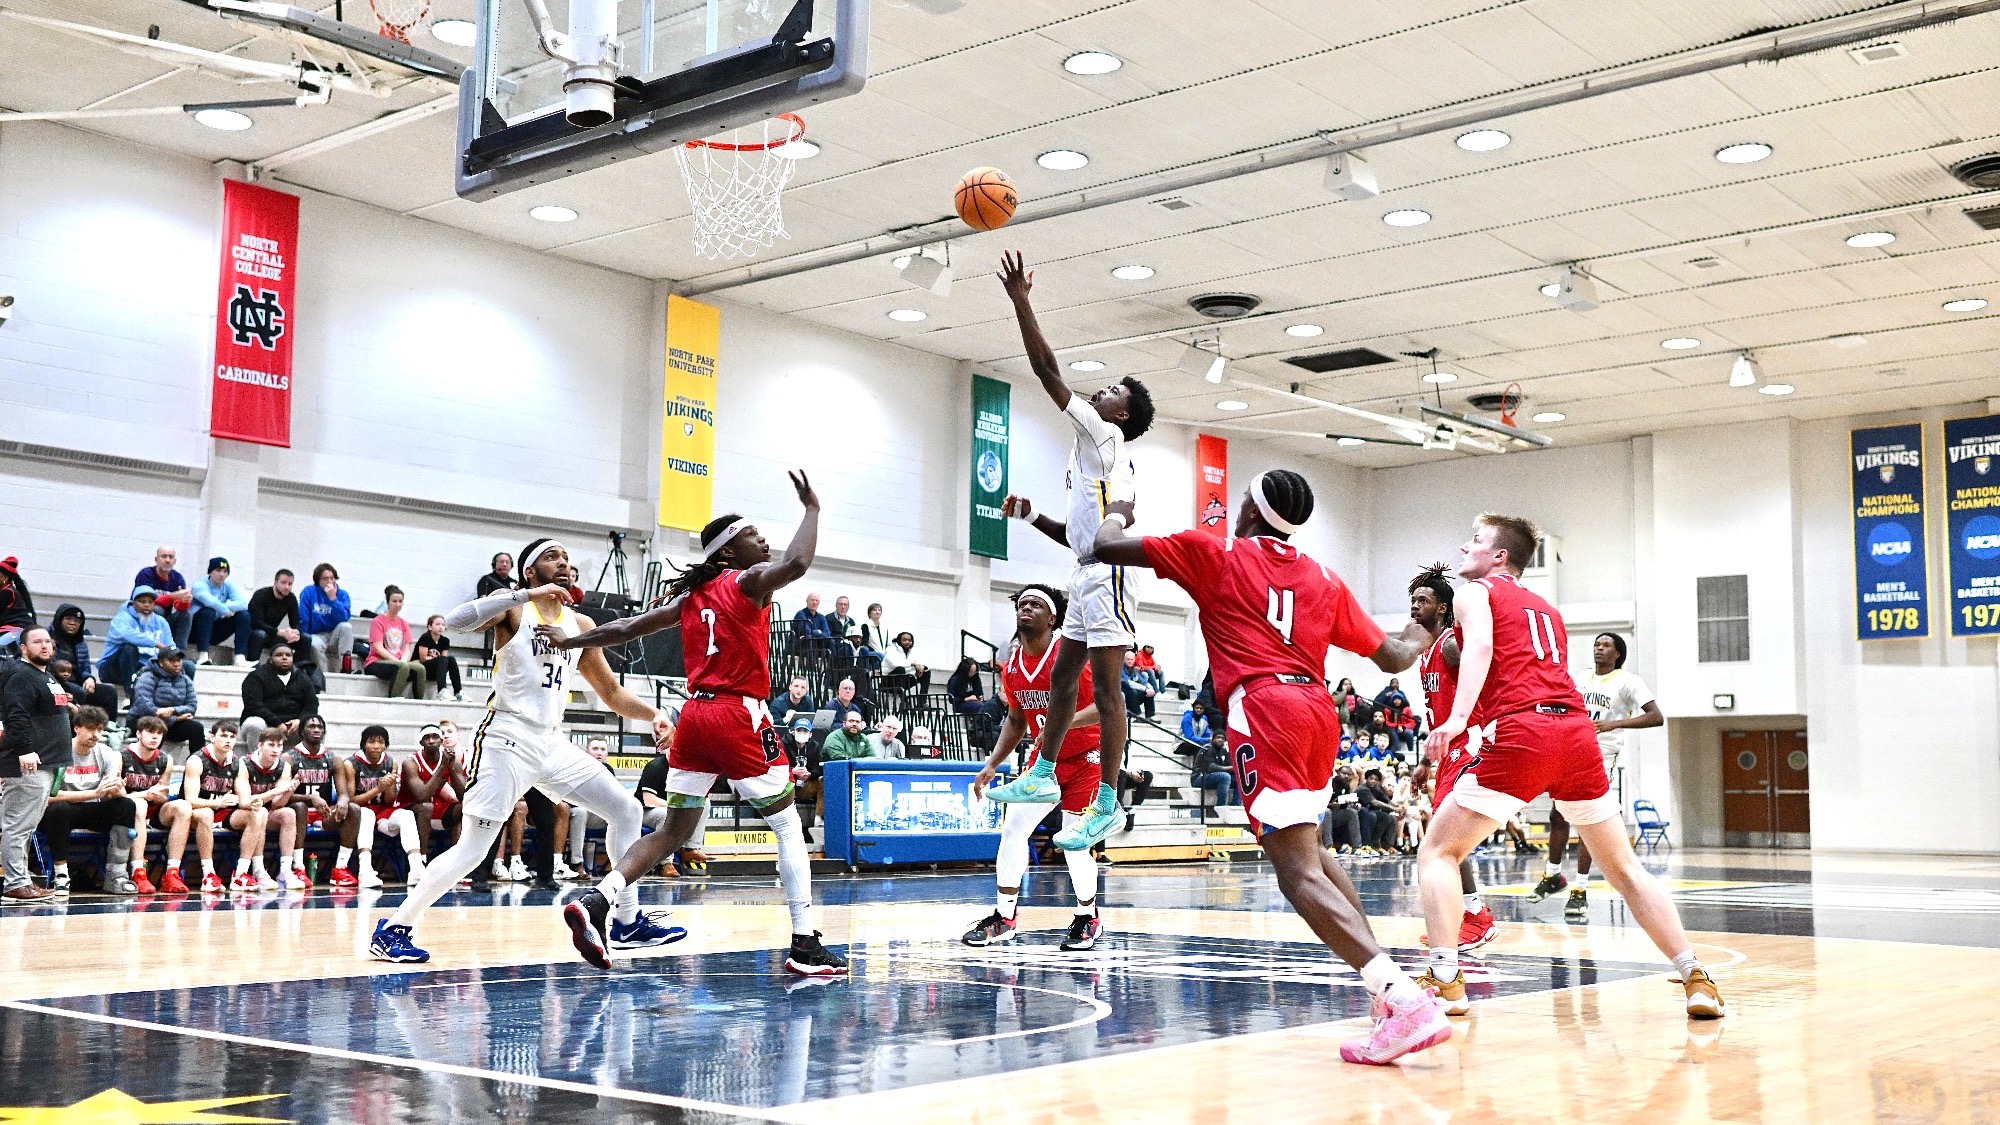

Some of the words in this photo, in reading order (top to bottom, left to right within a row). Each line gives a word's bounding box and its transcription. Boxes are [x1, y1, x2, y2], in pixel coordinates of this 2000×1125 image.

[240, 233, 279, 252] NORTH
[231, 246, 285, 269] CENTRAL
[235, 260, 281, 281] COLLEGE
[668, 348, 693, 363] NORTH
[696, 354, 715, 368] PARK
[217, 364, 289, 390] CARDINALS
[668, 359, 714, 378] UNIVERSITY
[666, 400, 713, 427] VIKINGS
[1984, 434, 2000, 442] PAR
[667, 457, 708, 476] VIKINGS
[1855, 450, 1919, 472] VIKINGS
[1862, 493, 1914, 507] NATIONAL
[1857, 502, 1920, 518] CHAMPIONS
[1871, 541, 1912, 556] NCAA
[1876, 581, 1906, 592] MEN'S
[1863, 590, 1921, 604] BASKETBALL
[1266, 584, 1295, 646] 4
[1867, 607, 1919, 631] 1978
[1961, 603, 2000, 628] 197
[700, 608, 720, 657] 2
[1523, 607, 1561, 664] 11
[541, 662, 563, 691] 34
[1583, 692, 1612, 710] IKINGS
[605, 734, 620, 747] ARK
[760, 726, 781, 764] B
[616, 758, 648, 769] VIKINGS
[1235, 743, 1258, 796] C
[712, 807, 734, 818] PARK
[734, 832, 768, 844] VIKINGS
